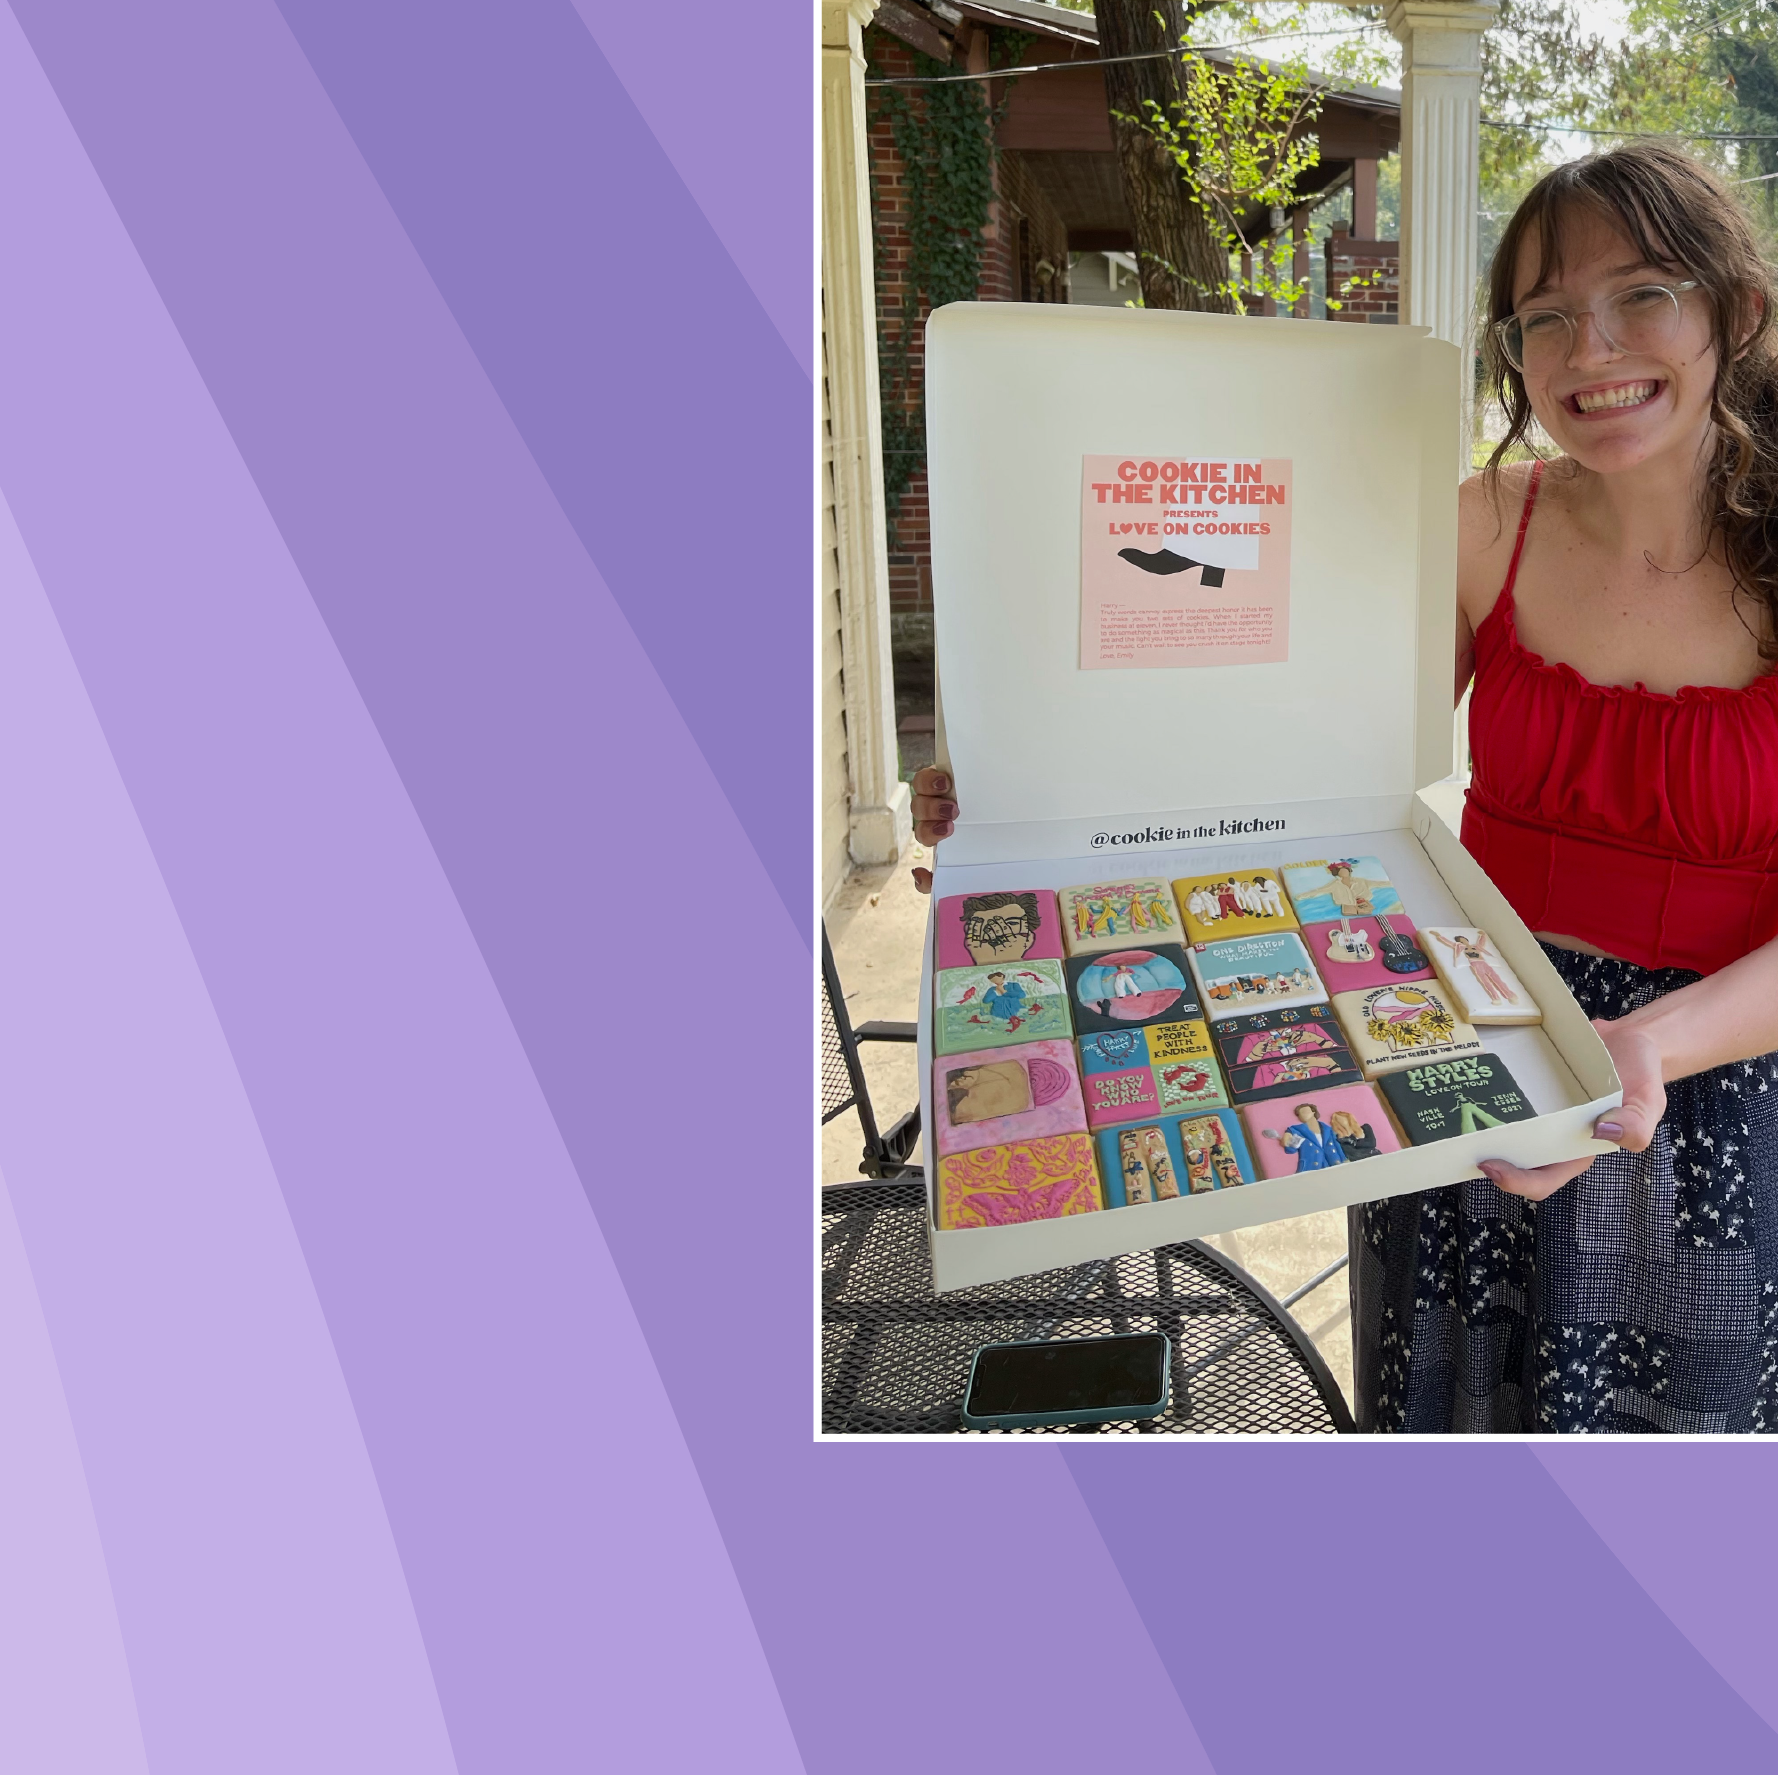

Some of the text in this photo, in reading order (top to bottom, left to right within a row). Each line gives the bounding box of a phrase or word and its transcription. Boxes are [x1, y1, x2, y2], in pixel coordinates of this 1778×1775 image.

[1117, 461, 1261, 483] COOKIE IN
[1092, 484, 1285, 505] THE KITCHEN
[1163, 510, 1218, 518] PRESENTS
[1163, 523, 1188, 535] ON
[1193, 523, 1270, 535] COOKIES
[1091, 818, 1286, 848] @cookie in the kitchen
[1156, 1030, 1197, 1041] PEOPLE
[1157, 1024, 1191, 1033] TREAT
[1164, 1038, 1193, 1048] WITH
[1154, 1045, 1208, 1059] KINDNESS
[1366, 1056, 1390, 1065] PLANT
[1406, 1056, 1478, 1082] HARRY
[1095, 1075, 1144, 1089] DO YOU
[1409, 1066, 1493, 1092] STYLES
[1101, 1081, 1143, 1095] KNOW
[1107, 1089, 1139, 1100] WHO
[1425, 1079, 1489, 1097] LOVE ON TOUR
[1419, 1113, 1445, 1123] VILLE
